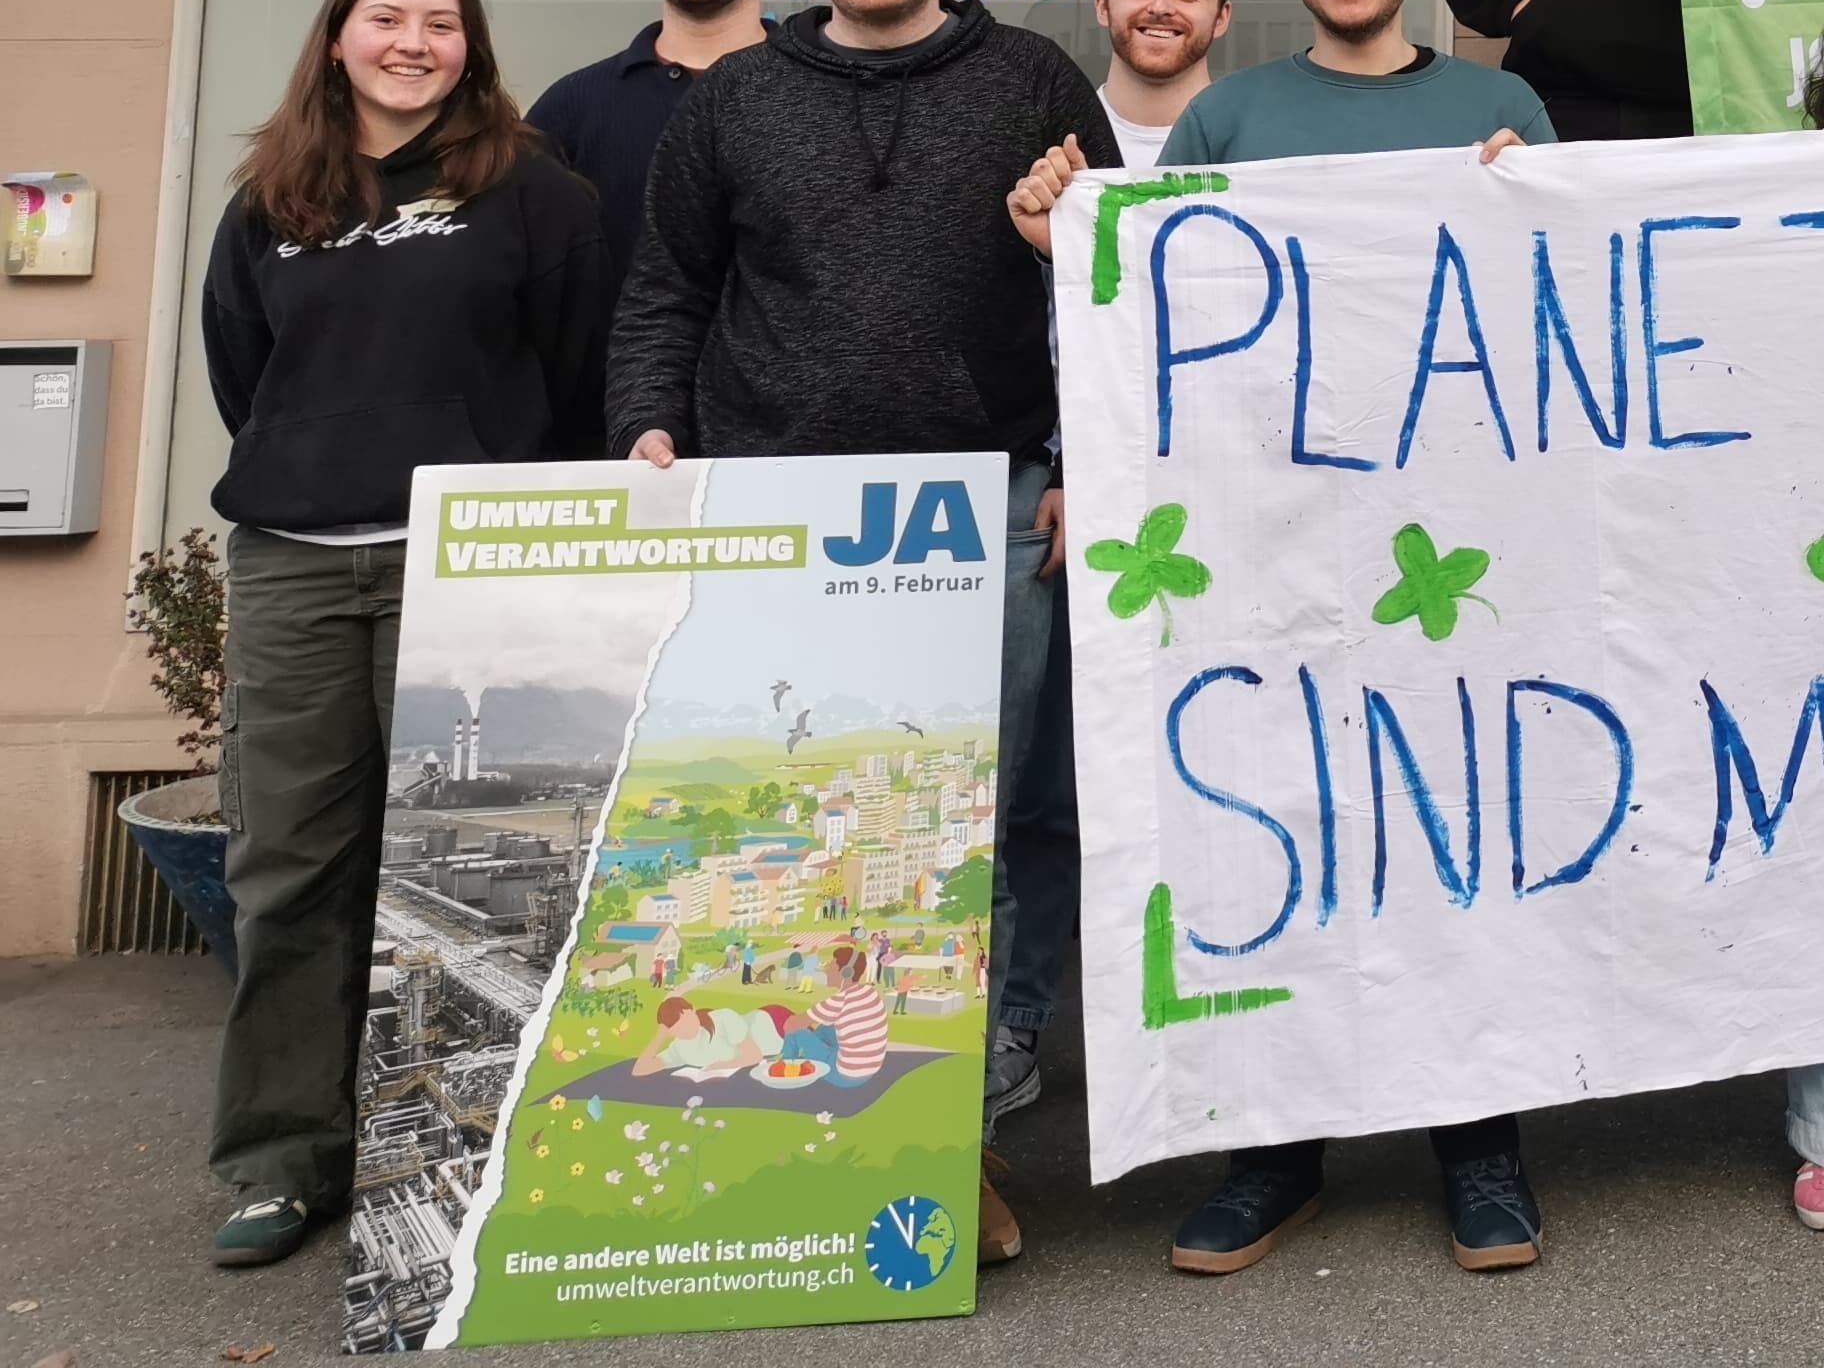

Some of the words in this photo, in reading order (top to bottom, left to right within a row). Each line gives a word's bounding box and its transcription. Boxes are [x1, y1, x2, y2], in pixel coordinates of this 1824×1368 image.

[450, 498, 617, 531] UMWELT
[823, 480, 987, 568] JA
[445, 535, 795, 572] VERANTWORTUNG
[824, 578, 860, 596] am
[866, 575, 887, 595] 9.
[894, 573, 985, 595] Februar
[1166, 663, 1635, 958] SIND
[505, 1250, 557, 1275] Eine
[563, 1246, 650, 1271] andere
[655, 1242, 710, 1266] Welt
[715, 1239, 746, 1262] ist
[751, 1232, 855, 1266] möglich!
[556, 1263, 855, 1302] umweltverantwortung.ch
